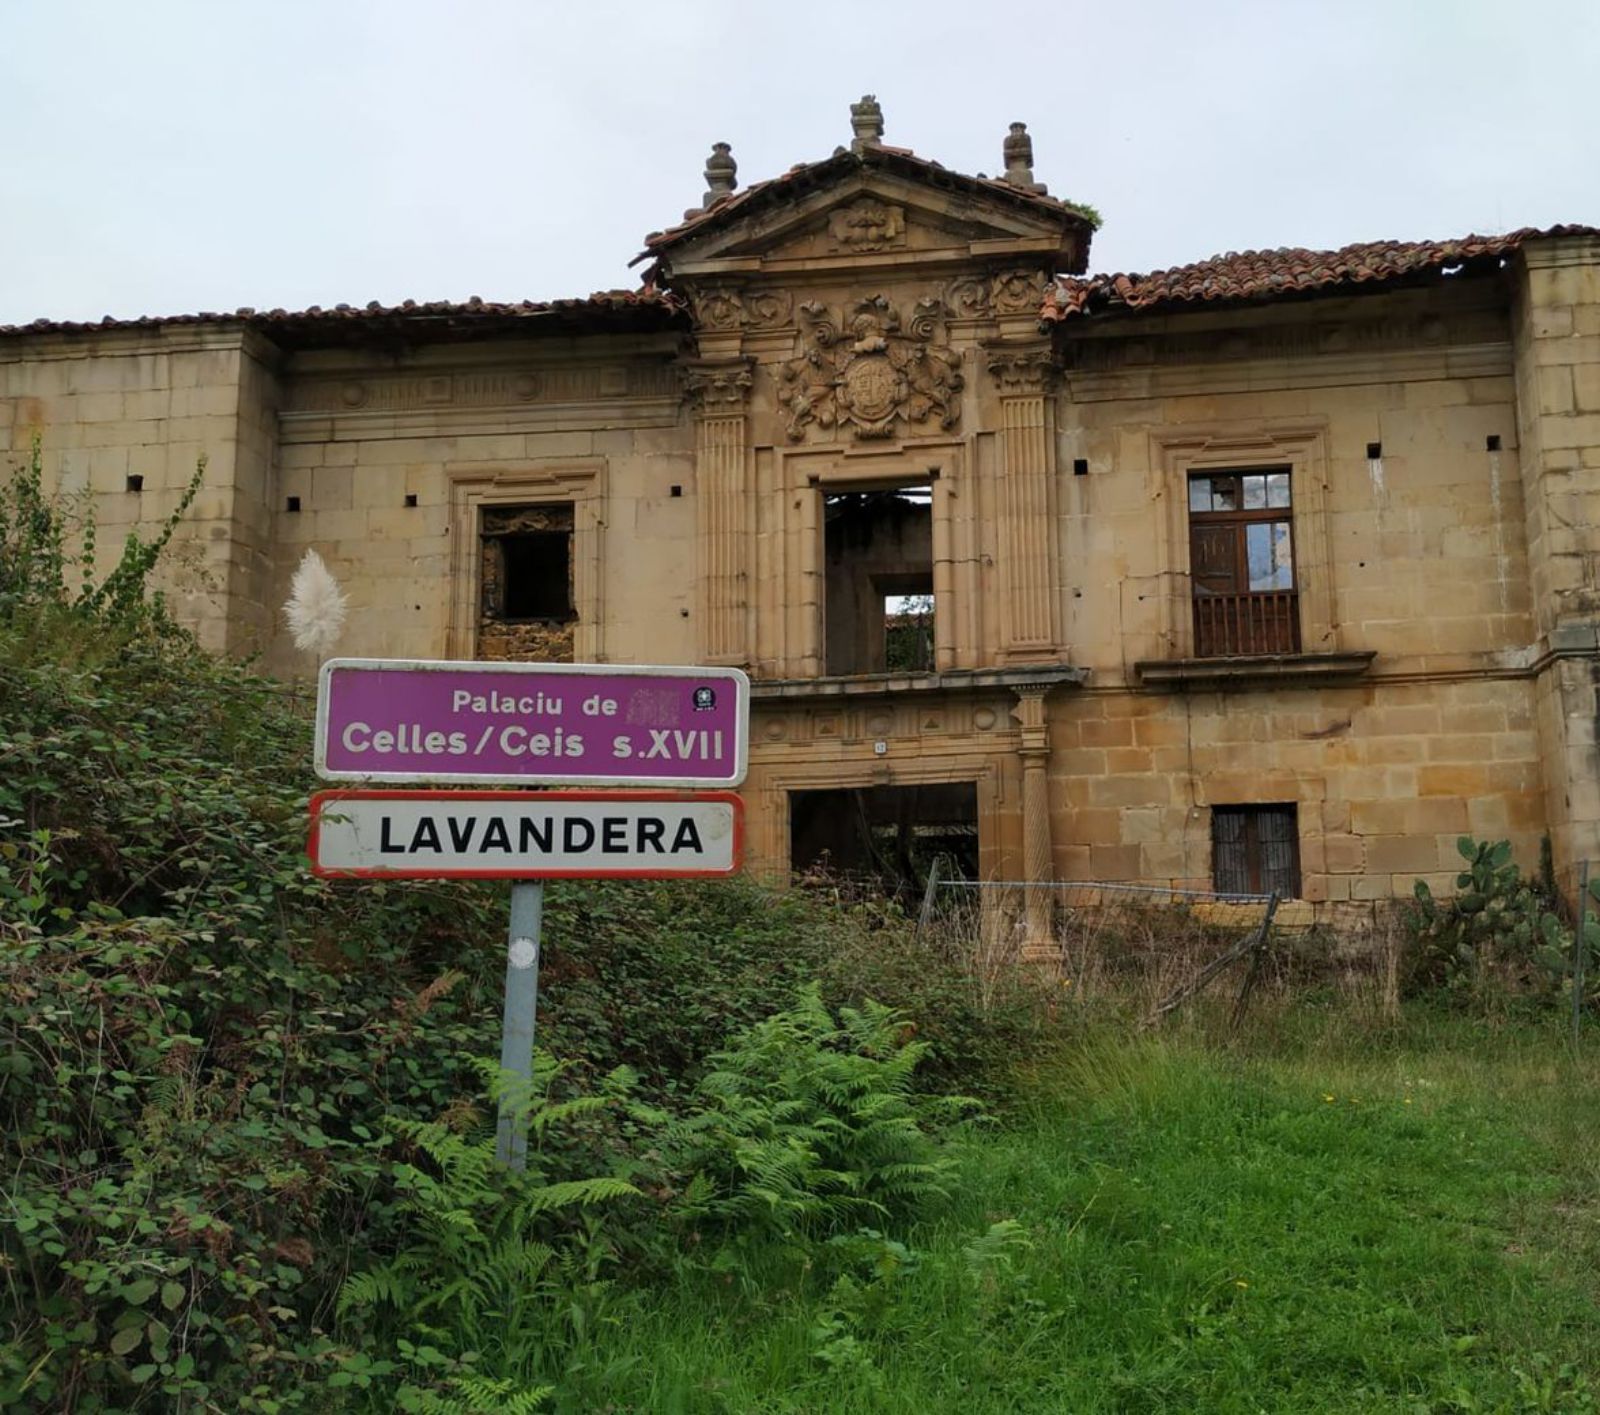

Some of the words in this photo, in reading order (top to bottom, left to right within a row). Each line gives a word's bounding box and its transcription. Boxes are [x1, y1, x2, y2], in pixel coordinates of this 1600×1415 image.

[453, 690, 562, 716] Palaciu
[582, 694, 618, 716] de
[341, 721, 585, 758] Celles/Ceis
[612, 729, 723, 760] s.XVII
[380, 816, 704, 854] LAVANDERA
